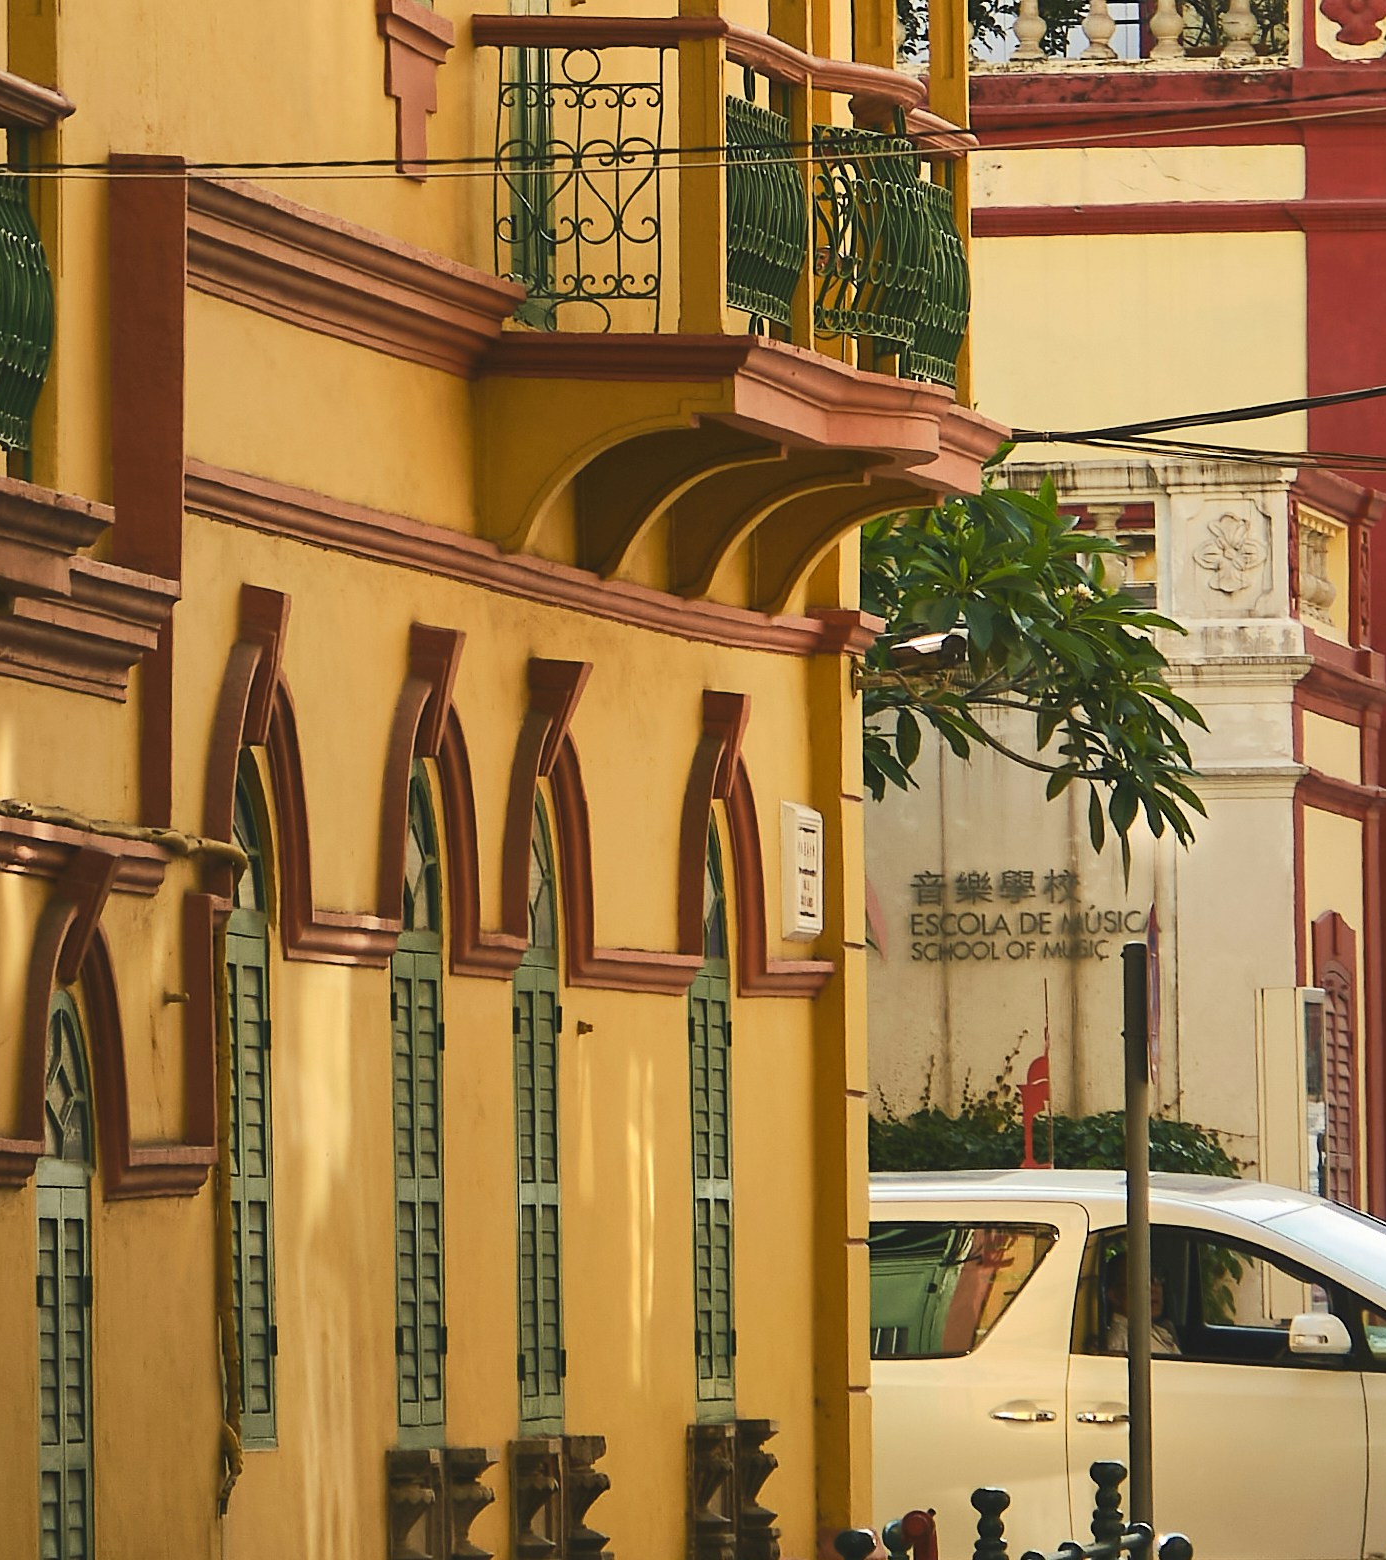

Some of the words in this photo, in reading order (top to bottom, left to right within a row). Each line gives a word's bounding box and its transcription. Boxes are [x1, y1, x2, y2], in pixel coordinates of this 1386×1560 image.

[910, 869, 1082, 907] 音樂學校
[910, 912, 1012, 937] ESCOLA
[1019, 912, 1053, 936] DE
[911, 940, 1001, 962] SCHOOL
[1006, 940, 1036, 960] OF
[1042, 939, 1110, 960] MUSIC
